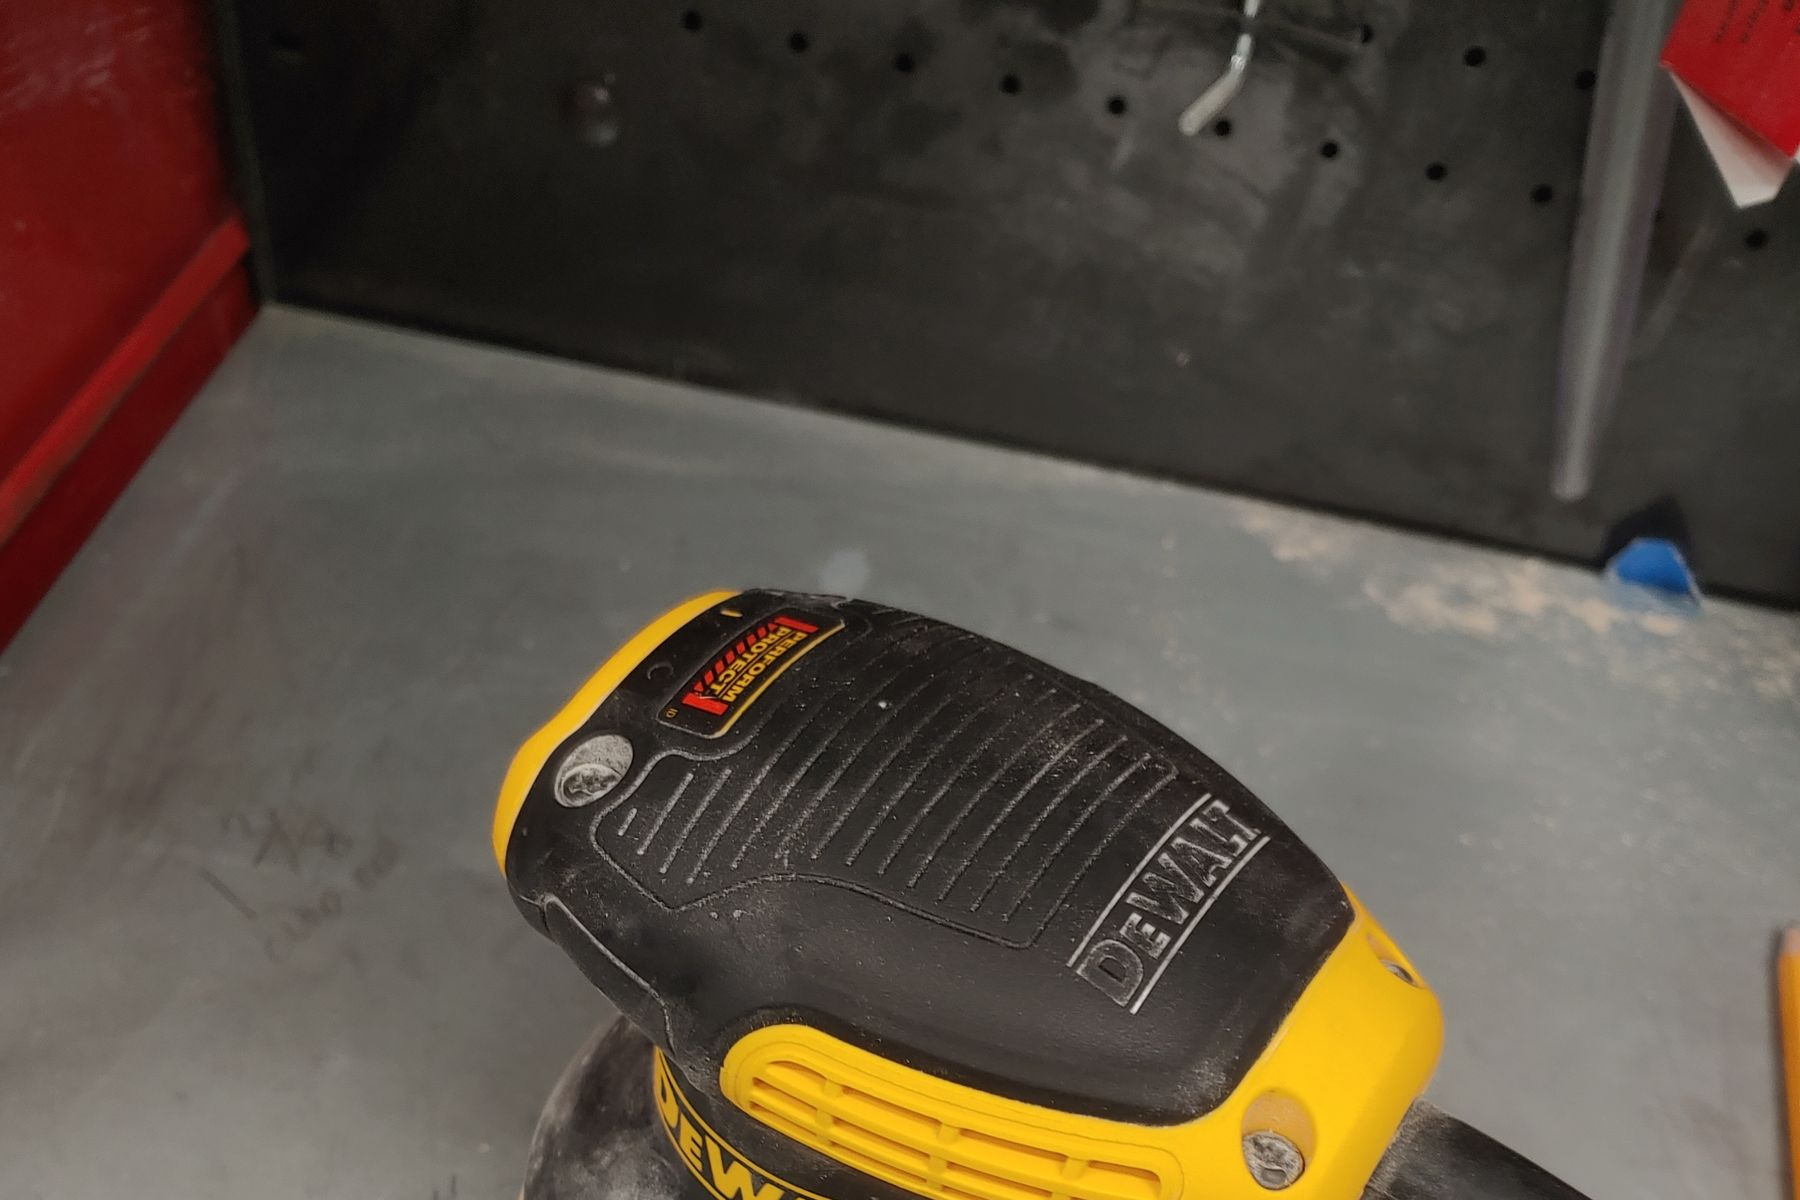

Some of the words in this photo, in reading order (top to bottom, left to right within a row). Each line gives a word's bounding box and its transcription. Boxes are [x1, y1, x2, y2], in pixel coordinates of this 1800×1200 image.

[709, 626, 793, 695] PROTECT
[723, 631, 808, 703] PERFORM
[1076, 799, 1262, 1008] DEWALT
